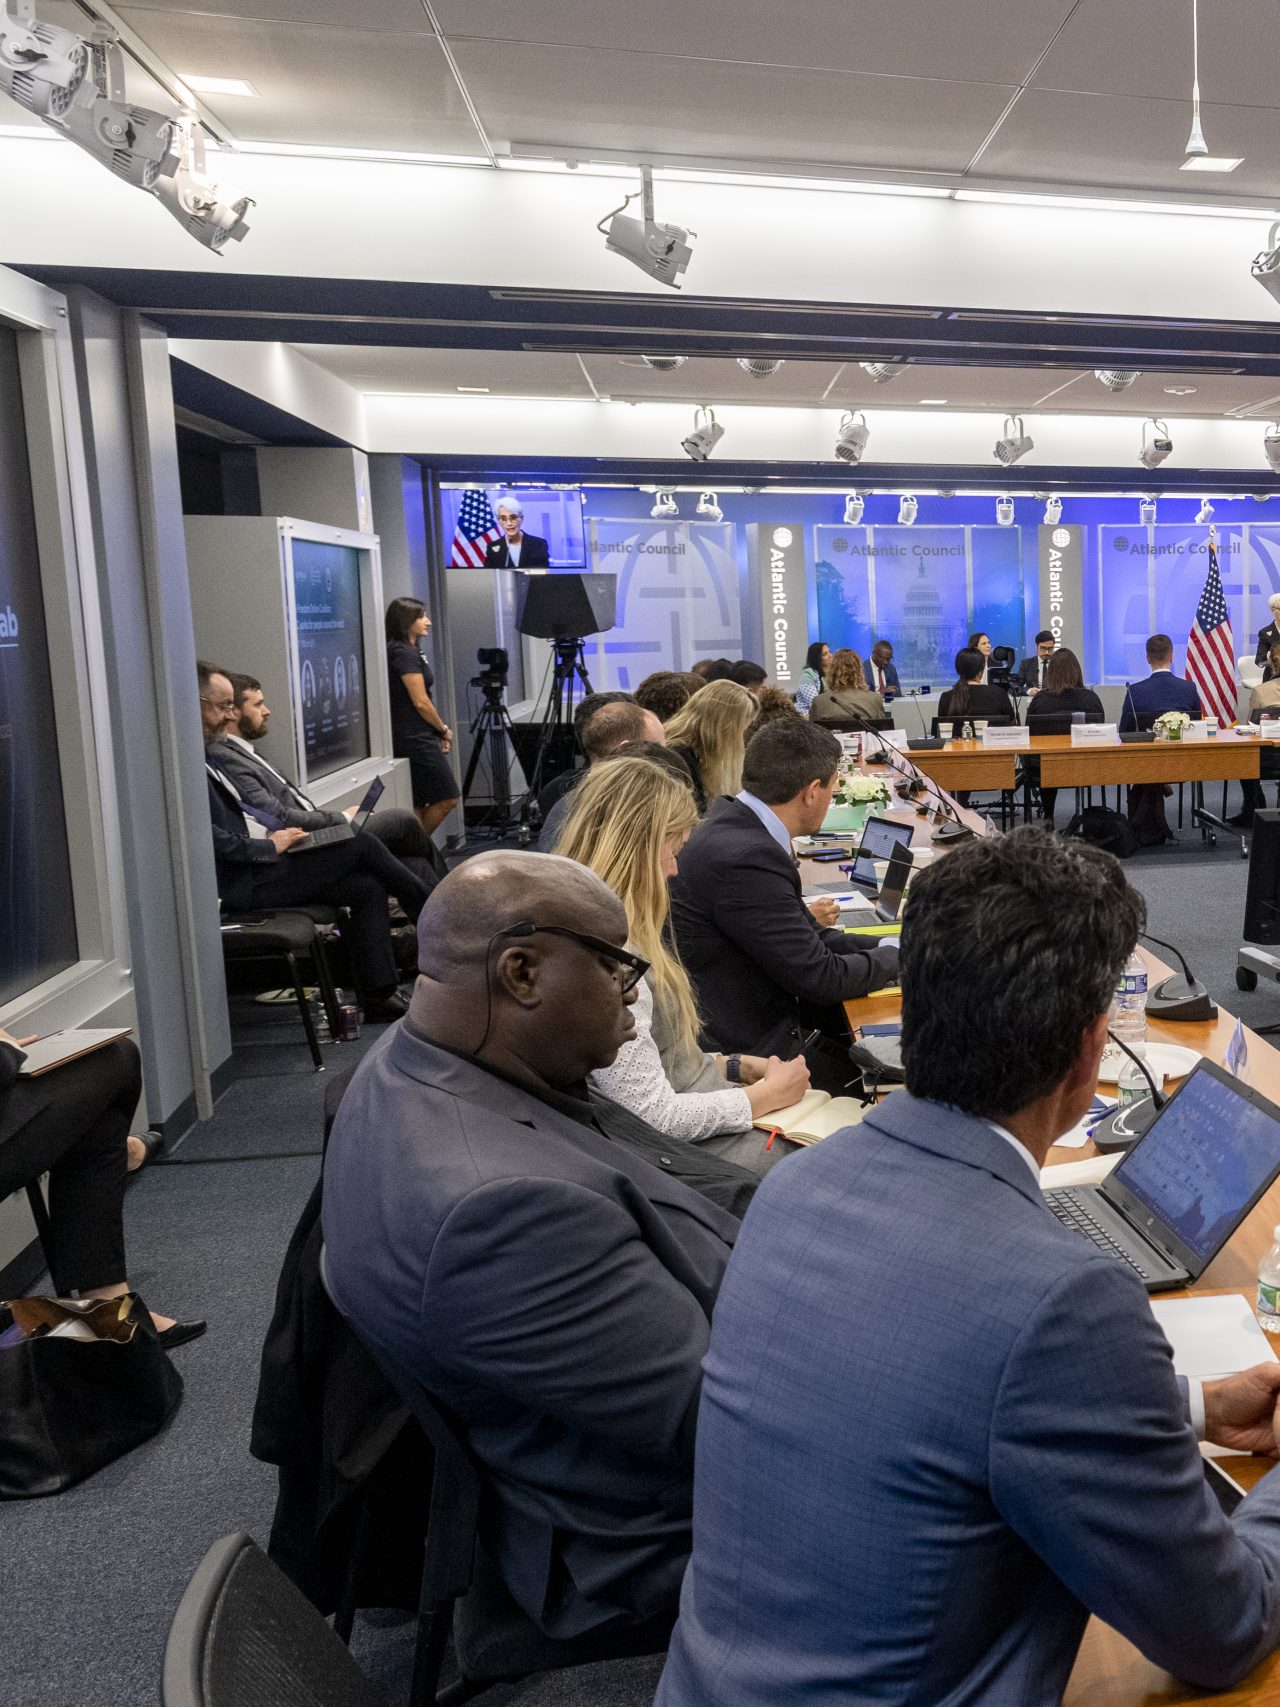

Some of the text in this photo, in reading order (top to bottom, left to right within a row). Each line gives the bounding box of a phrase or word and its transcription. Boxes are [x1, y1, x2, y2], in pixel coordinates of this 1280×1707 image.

[587, 541, 686, 555] tlantic Council
[850, 545, 965, 556] Atlantic Council
[1130, 543, 1241, 555] Atlantic Concil
[1049, 548, 1063, 612] Atlantic
[770, 548, 791, 681] Atlantic Council
